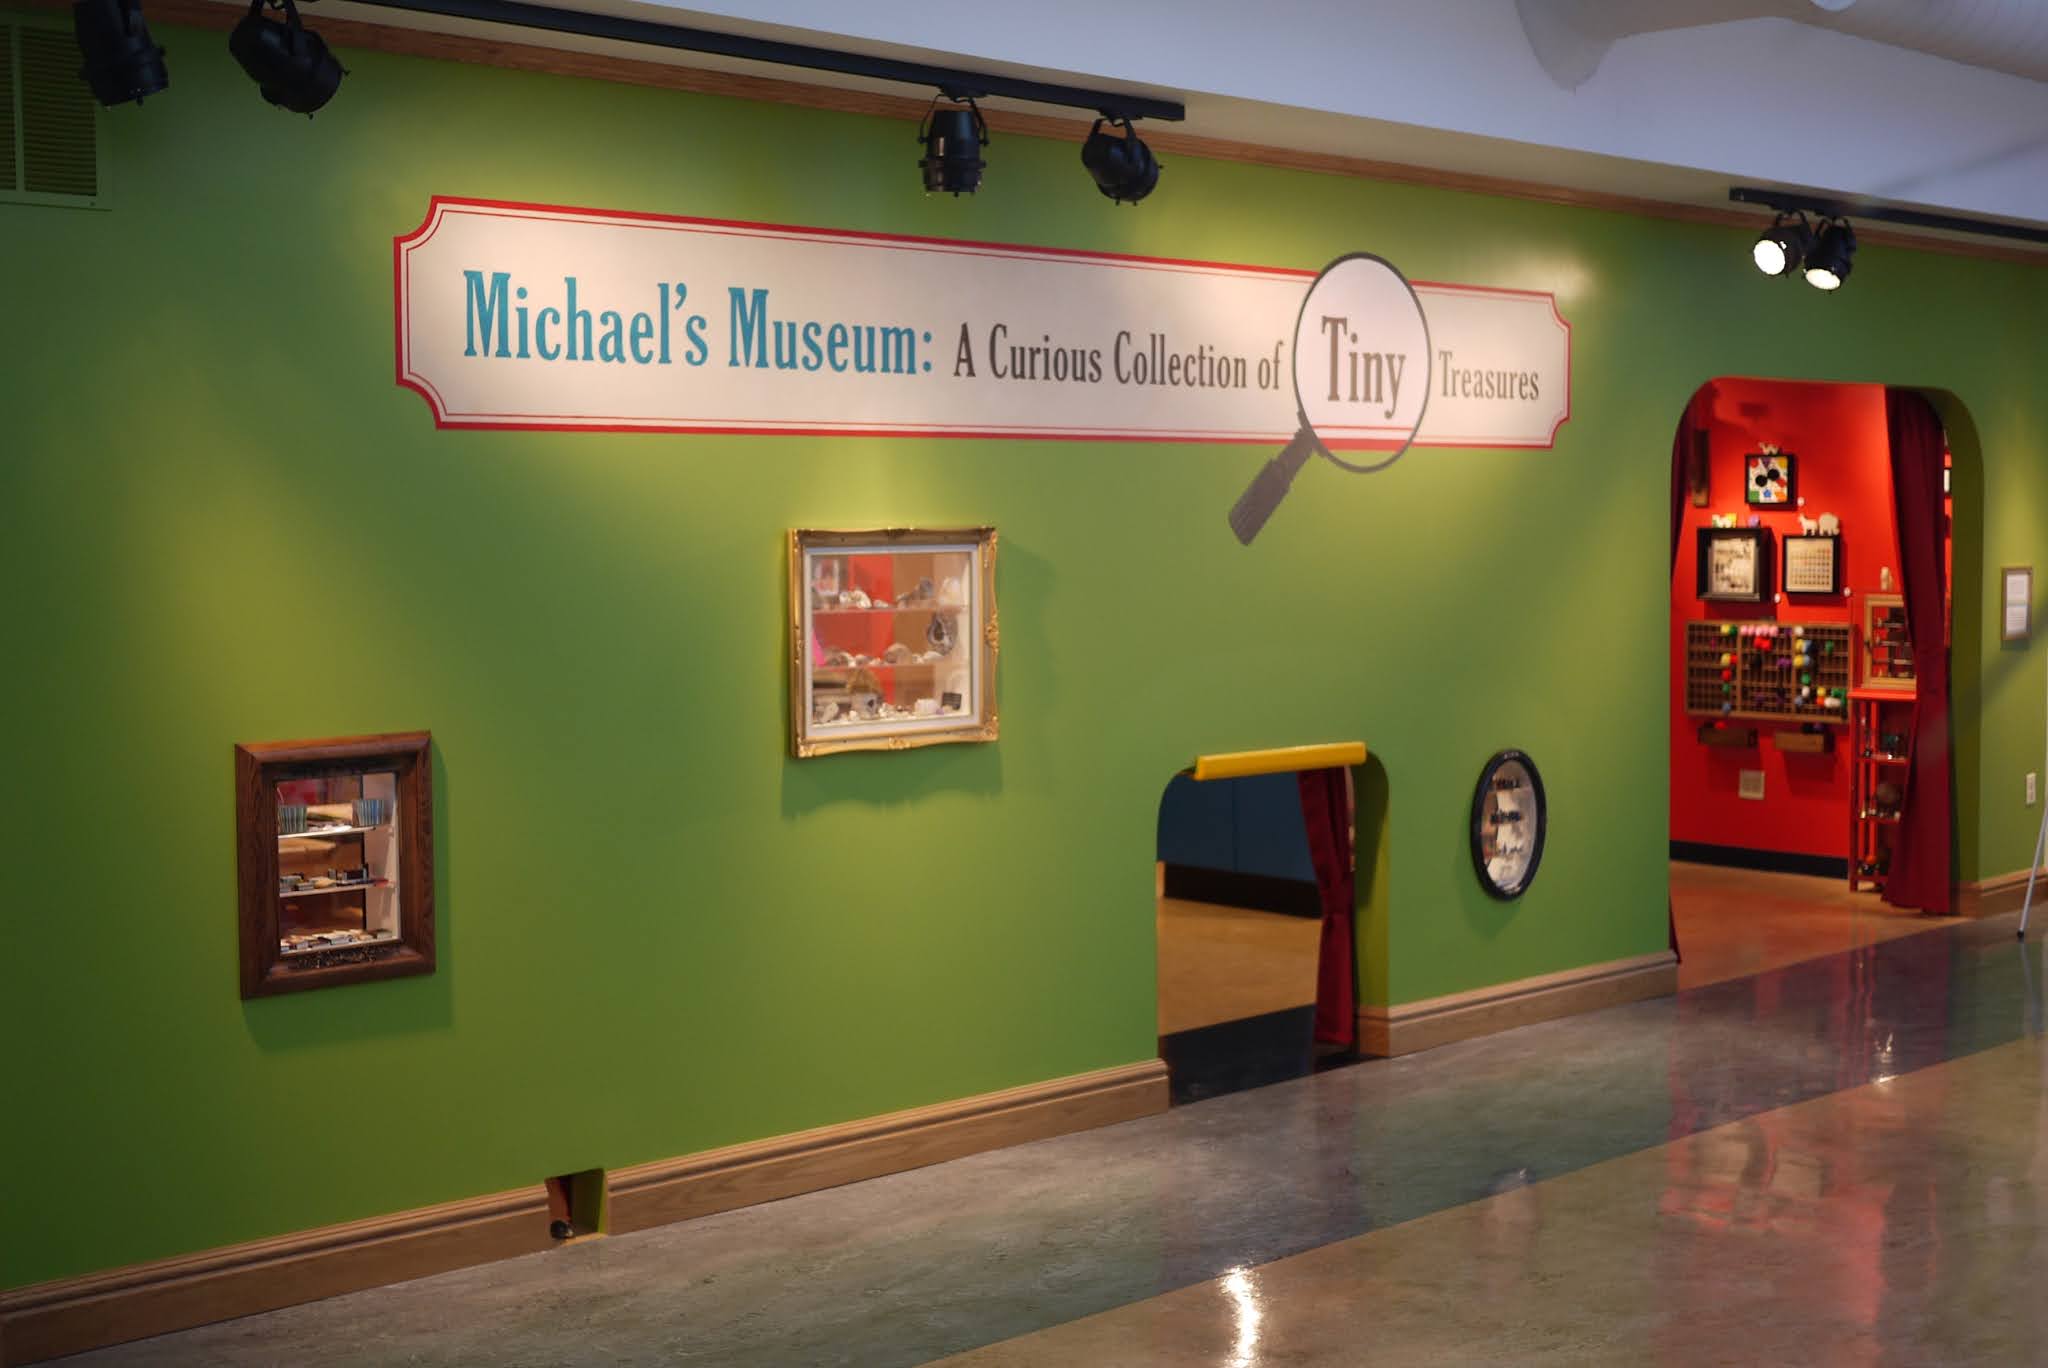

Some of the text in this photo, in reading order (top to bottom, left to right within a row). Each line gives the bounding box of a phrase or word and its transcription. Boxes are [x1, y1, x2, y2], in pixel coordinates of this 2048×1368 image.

[463, 270, 1540, 419] Michael's Museum: A Curious Collection of Tiny Treasures
